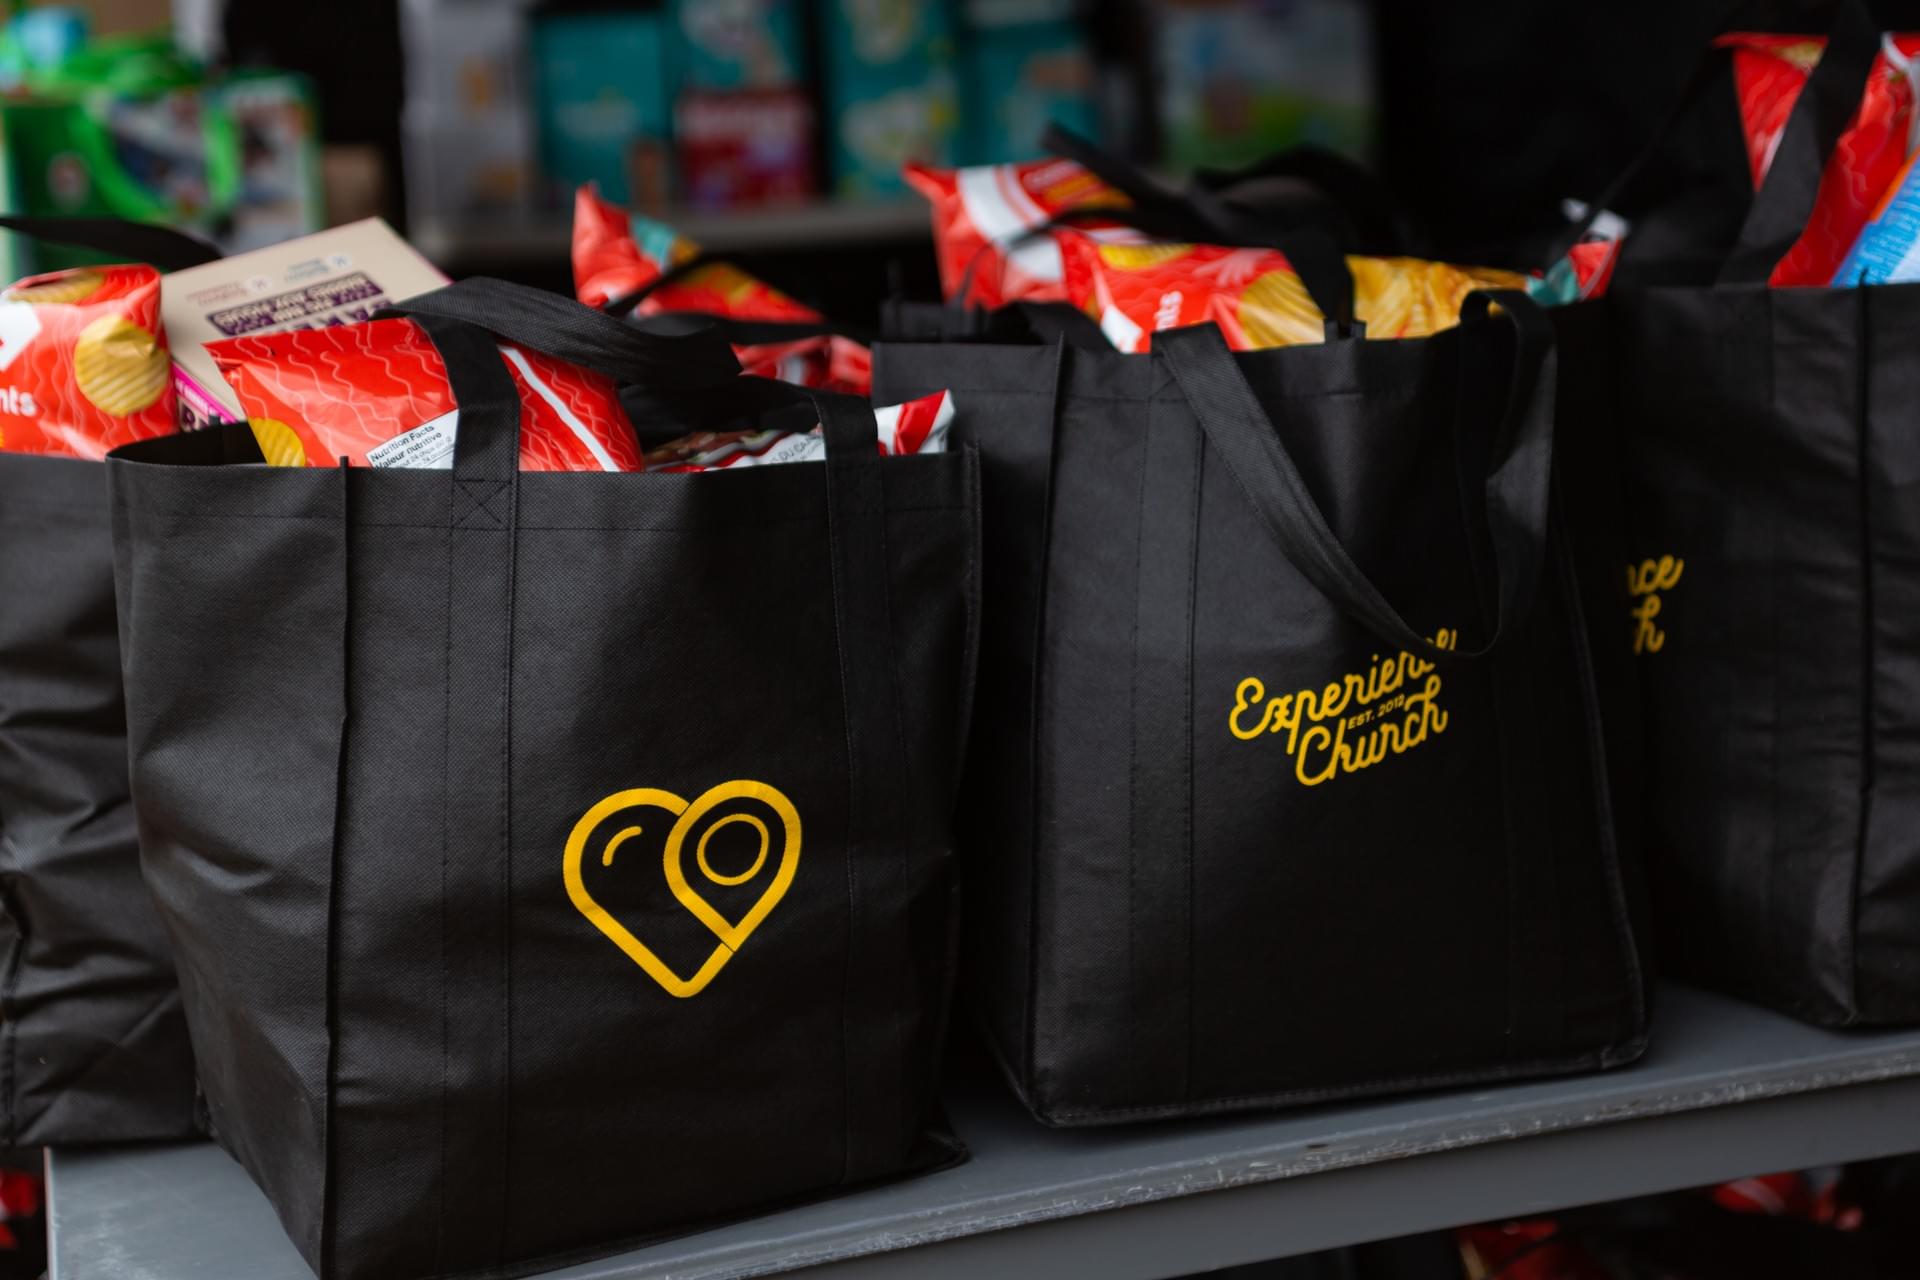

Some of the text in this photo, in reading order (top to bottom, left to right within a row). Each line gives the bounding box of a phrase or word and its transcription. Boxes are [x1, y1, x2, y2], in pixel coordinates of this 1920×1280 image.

[370, 437, 409, 462] Nutrition
[410, 425, 435, 441] Facts
[406, 432, 442, 455] nutritive
[1296, 674, 1448, 786] Church
[1347, 709, 1375, 730] EST.
